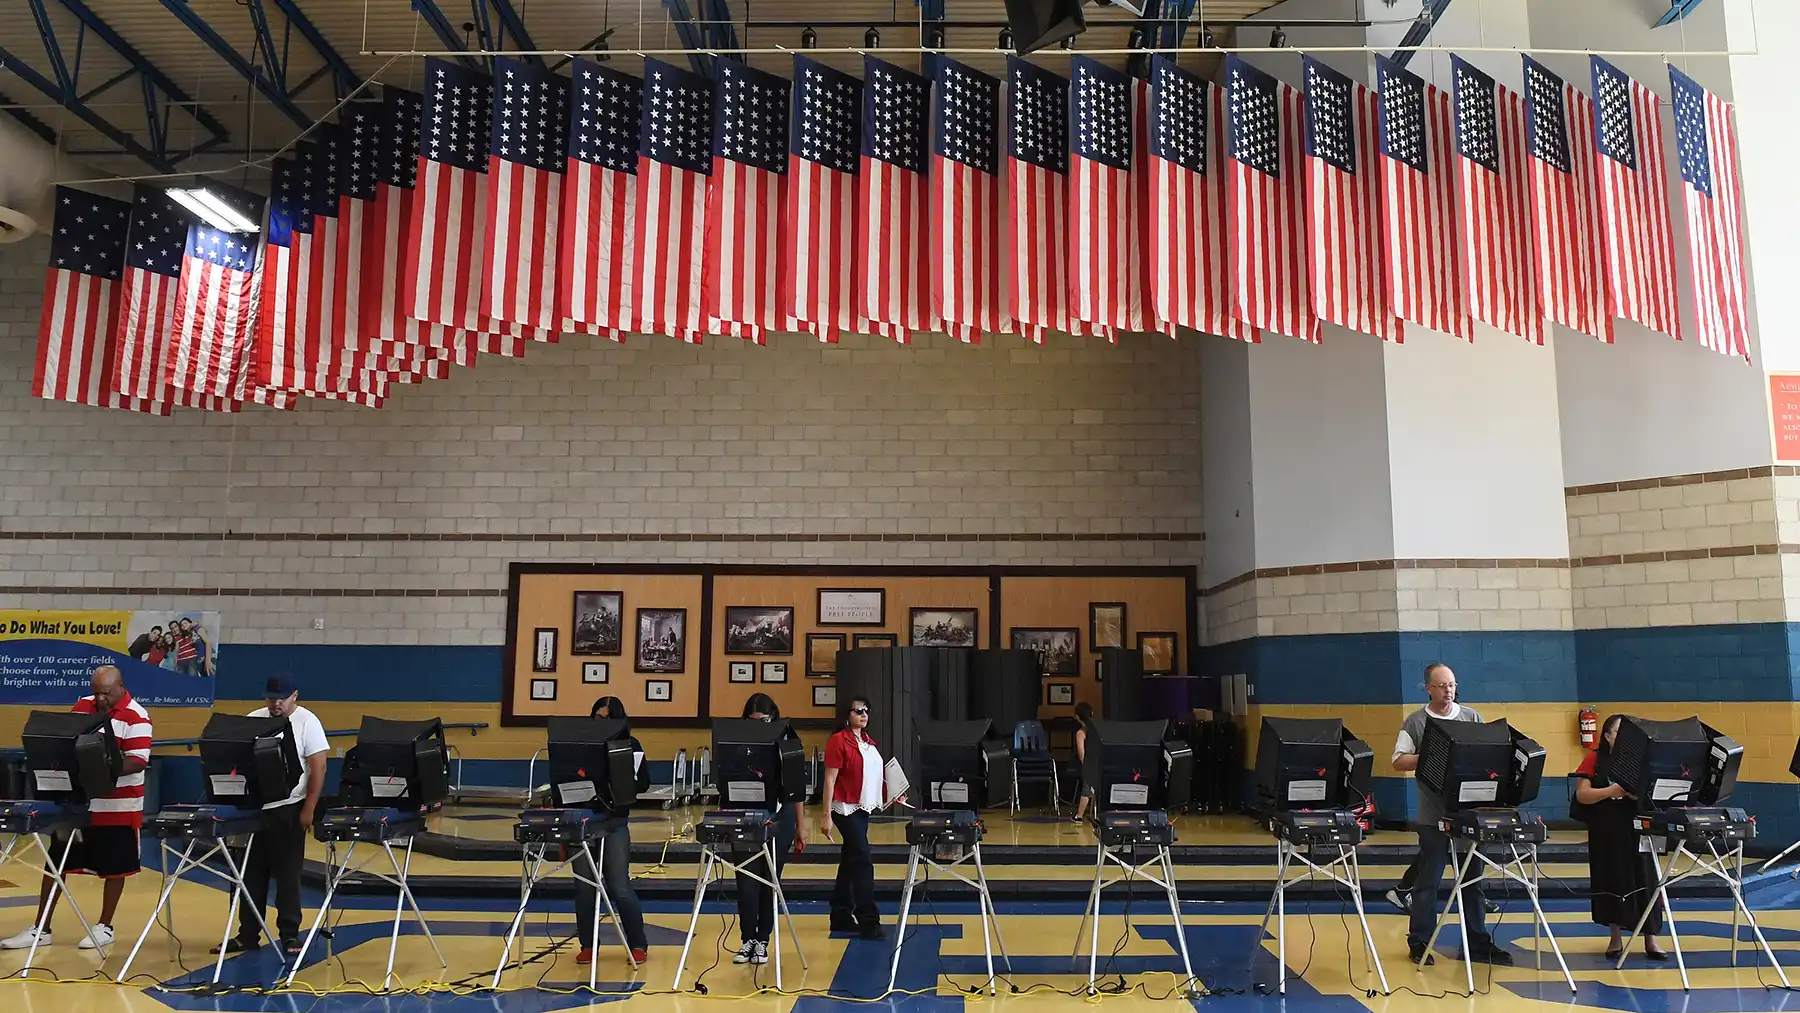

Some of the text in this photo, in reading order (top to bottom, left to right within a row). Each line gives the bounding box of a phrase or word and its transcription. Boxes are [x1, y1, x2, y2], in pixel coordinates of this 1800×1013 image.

[0, 620, 122, 635] o Do What You Love!
[38, 656, 55, 664] 100
[90, 655, 116, 664] fields
[33, 666, 59, 676] from,
[61, 669, 83, 677] your
[3, 677, 91, 688] brighter with us in
[162, 696, 181, 704] More.
